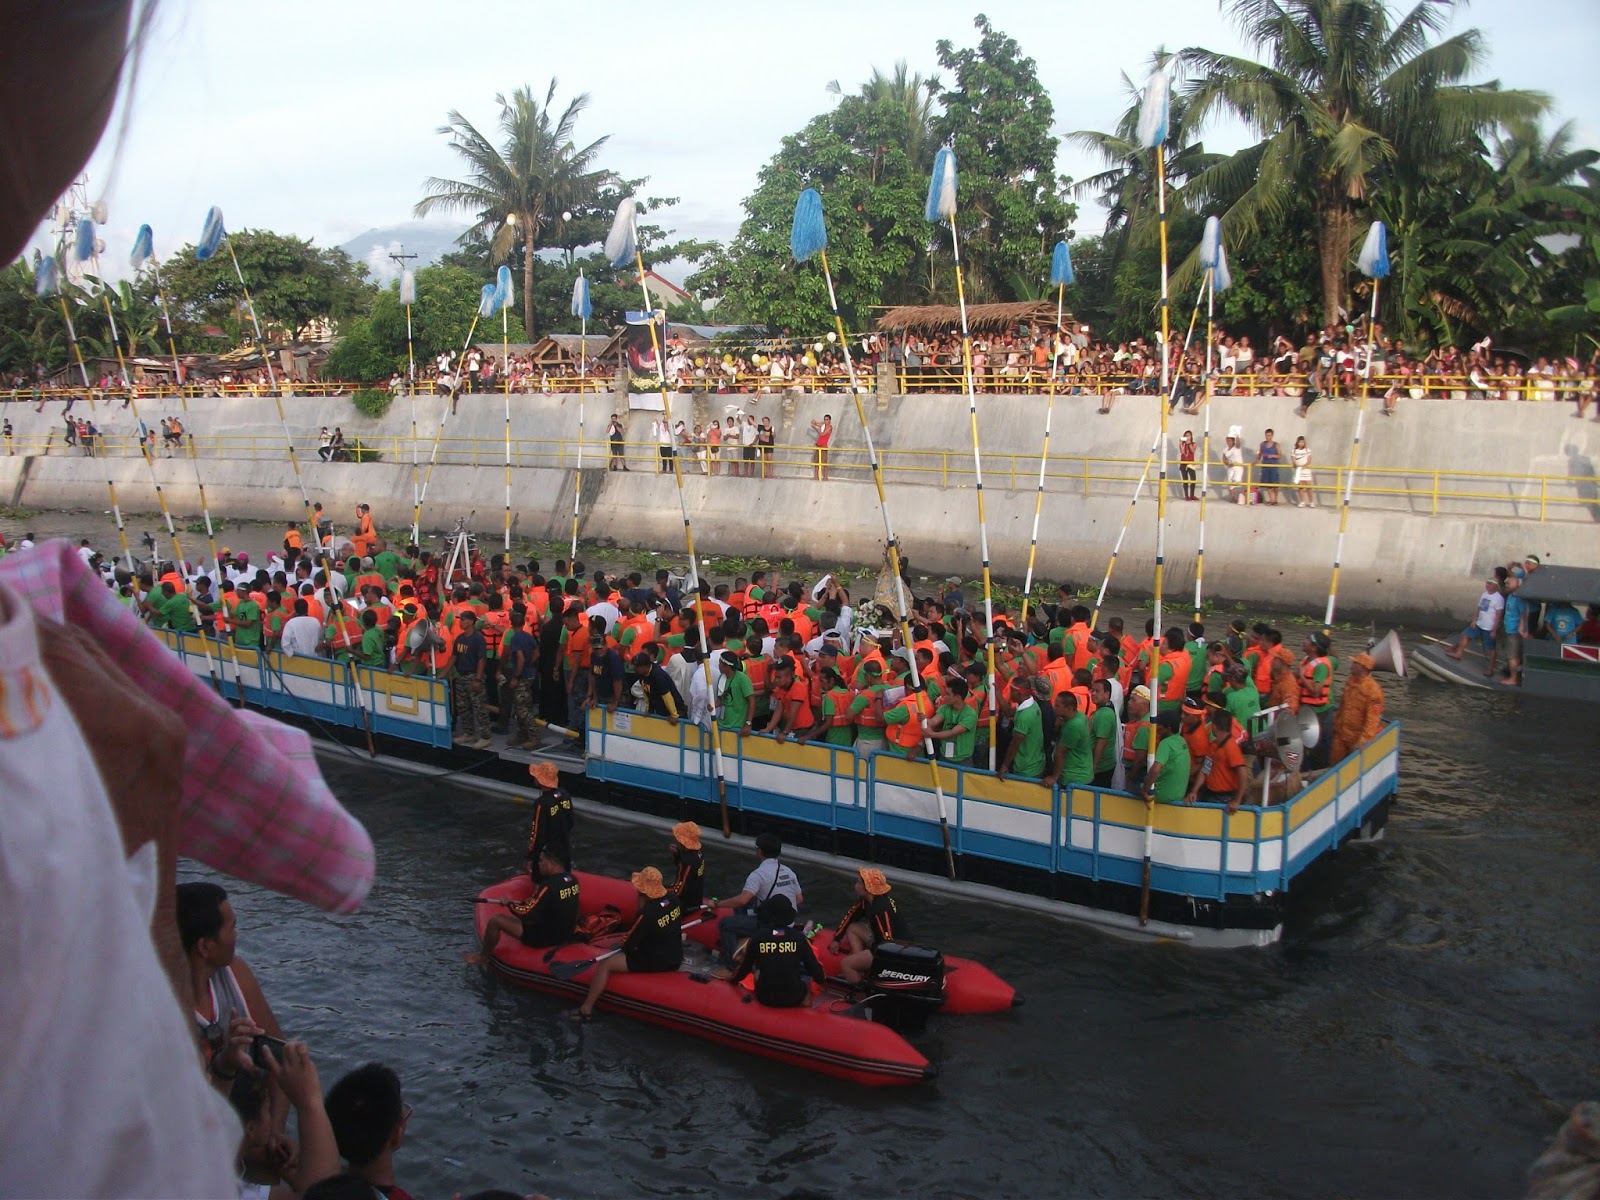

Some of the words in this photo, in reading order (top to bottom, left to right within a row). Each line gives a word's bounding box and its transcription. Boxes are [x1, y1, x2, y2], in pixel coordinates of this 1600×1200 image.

[560, 887, 571, 900] BFP
[657, 914, 670, 928] BFP
[759, 942, 777, 954] BFP
[778, 941, 797, 953] SRU
[880, 969, 931, 983] MERCURY
